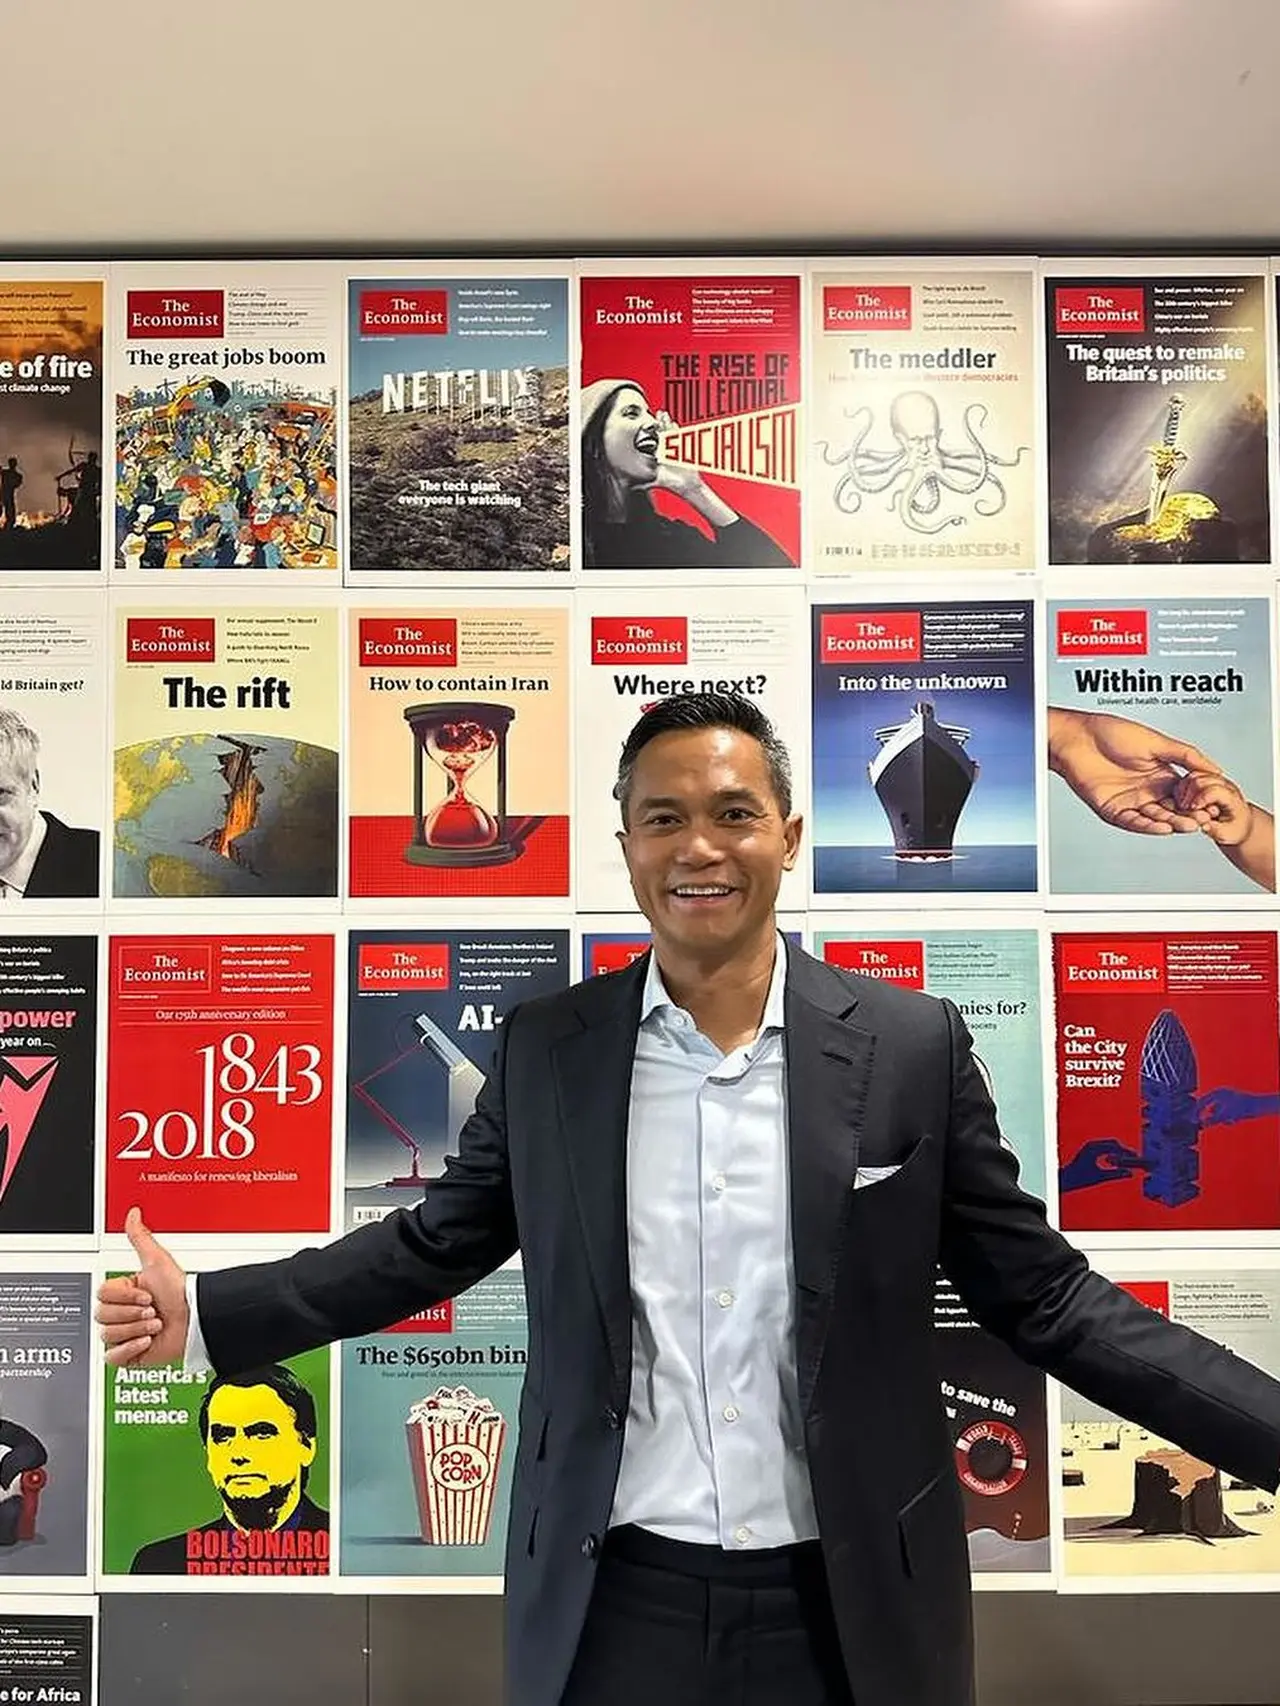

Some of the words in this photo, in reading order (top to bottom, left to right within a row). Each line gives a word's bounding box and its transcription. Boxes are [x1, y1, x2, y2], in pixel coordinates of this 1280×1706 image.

[162, 299, 189, 312] The
[392, 298, 417, 310] The
[625, 296, 653, 309] The
[856, 294, 881, 306] The
[1088, 296, 1113, 308] The
[132, 312, 220, 327] Economist
[364, 311, 443, 325] Economist
[596, 310, 683, 324] Economist
[828, 307, 907, 321] Economist
[1061, 308, 1139, 322] Economist
[127, 350, 164, 365] The
[168, 351, 220, 369] great
[223, 349, 262, 369] jobs
[265, 349, 326, 365] boom
[850, 349, 892, 369] The
[899, 348, 996, 369] meddler
[1066, 344, 1099, 360] The
[1102, 345, 1152, 364] quest
[1155, 346, 1174, 360] to
[1177, 344, 1245, 360] remake
[18, 355, 45, 378] of
[49, 355, 93, 378] fire
[661, 354, 699, 376] THE
[709, 354, 755, 376] RISE
[765, 354, 789, 376] OF
[1086, 366, 1159, 381] Britain's
[1161, 365, 1227, 385] politics
[8, 383, 39, 392] climate
[40, 384, 71, 395] change
[383, 367, 537, 414] NETFLIX
[665, 409, 795, 483] SOCIALISM
[418, 481, 441, 491] The
[443, 480, 469, 492] tech
[471, 481, 501, 495] giant
[398, 496, 453, 508] everyone
[455, 495, 465, 505] is
[468, 495, 521, 507] watching
[856, 623, 886, 636] The
[1091, 618, 1116, 631] The
[159, 626, 185, 638] The
[394, 627, 423, 641] The
[625, 626, 653, 639] The
[1062, 631, 1143, 645] Economist
[132, 639, 211, 652] Economist
[364, 641, 452, 656] Economist
[596, 639, 683, 654] Economist
[827, 636, 914, 651] Economist
[15, 678, 57, 690] Britain
[60, 680, 84, 693] get?
[370, 677, 411, 691] How
[415, 678, 434, 691] to
[437, 676, 507, 691] contain
[512, 677, 549, 691] Iran
[614, 675, 694, 695] Where
[701, 675, 767, 695] next?
[839, 676, 877, 691] Into
[881, 675, 911, 690] the
[915, 673, 1007, 690] unknown
[1075, 669, 1163, 693] Within
[1171, 668, 1243, 693] reach
[163, 677, 226, 708] The
[237, 677, 291, 708] rift
[1097, 697, 1133, 705] Universal
[1136, 697, 1160, 705] health
[1182, 697, 1221, 705] worldwide
[154, 955, 178, 967] The
[392, 953, 417, 966] The
[860, 950, 888, 964] The
[1098, 952, 1128, 966] The
[124, 968, 205, 982] Economist
[364, 966, 444, 980] Economist
[834, 963, 918, 978] onomist
[1068, 966, 1159, 981] Economist
[155, 1010, 173, 1019] Our
[199, 1010, 250, 1020] anniversary
[252, 1009, 286, 1019] edition
[997, 1001, 1026, 1015] for?
[0, 1010, 76, 1033] power
[1064, 1024, 1095, 1038] Can
[1064, 1041, 1093, 1054] the
[1094, 1041, 1127, 1057] City
[1065, 1058, 1125, 1071] survive
[1066, 1074, 1122, 1087] Brexit?
[139, 1172, 146, 1181] A
[148, 1171, 193, 1181] manifesto
[194, 1172, 207, 1181] for
[208, 1172, 251, 1183] renewing
[253, 1171, 298, 1181] liberalism
[13, 1348, 72, 1364] arms
[356, 1347, 398, 1365] The
[403, 1346, 484, 1368] $650bn
[491, 1346, 527, 1364] bin
[115, 1386, 168, 1404] latest
[941, 1381, 955, 1396] to
[956, 1389, 990, 1408] save
[992, 1398, 1016, 1417] the
[115, 1410, 189, 1424] menace
[440, 1451, 472, 1467] POP
[441, 1465, 481, 1484] CORN
[187, 1530, 329, 1559] BOLSONARO
[11, 1687, 34, 1701] for
[36, 1687, 81, 1701] Africa
